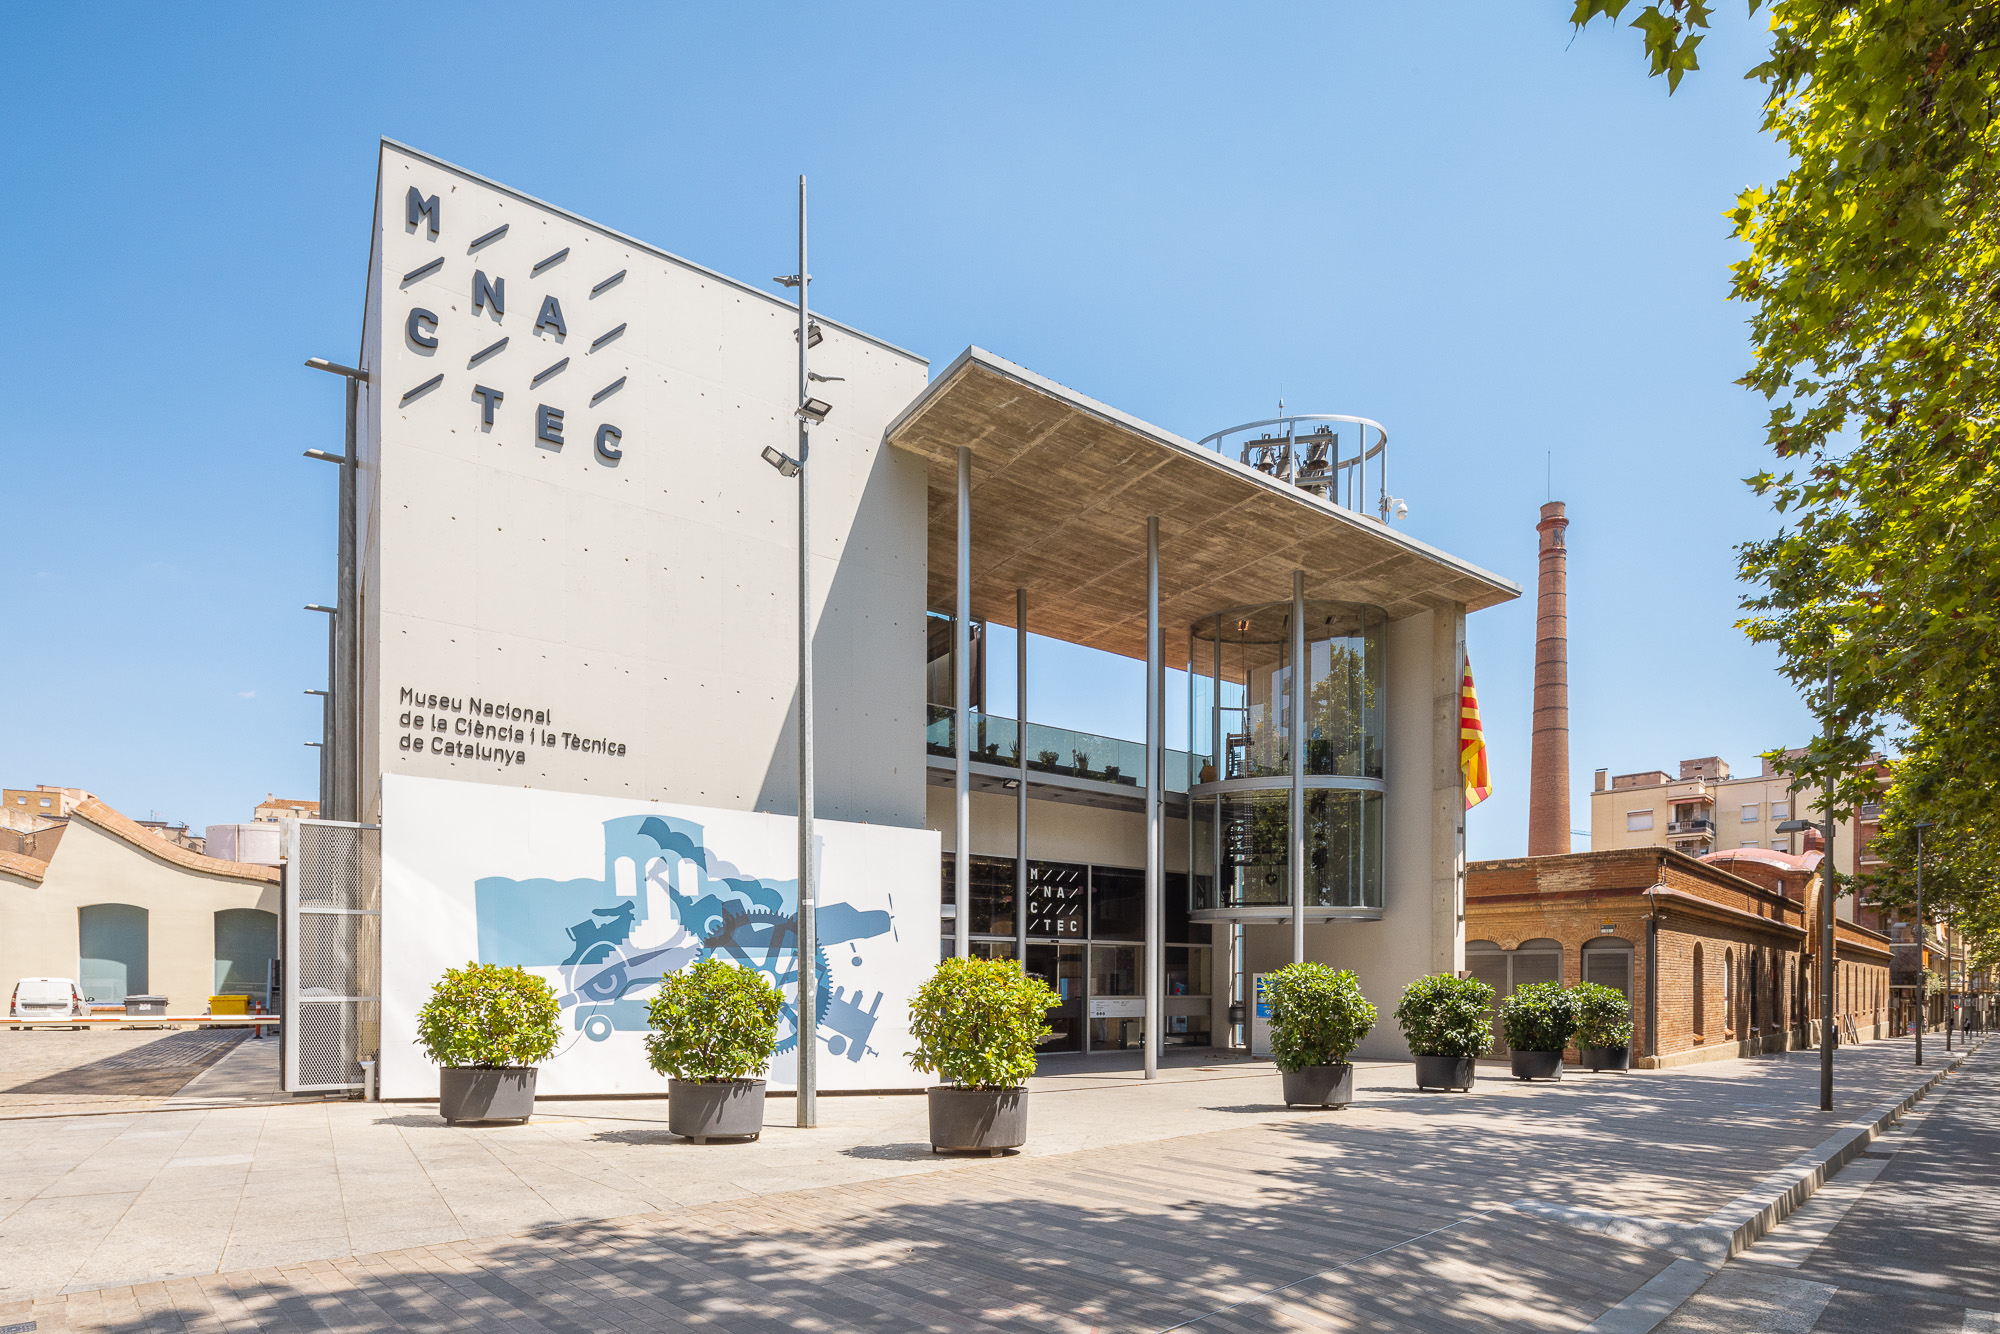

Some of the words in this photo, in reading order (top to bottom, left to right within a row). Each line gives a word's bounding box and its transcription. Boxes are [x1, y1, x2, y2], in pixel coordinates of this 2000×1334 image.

[399, 686, 462, 713] Museu
[469, 697, 552, 726] Nacional
[399, 711, 425, 731] de
[431, 713, 448, 734] la
[455, 717, 525, 744] Ciència
[530, 727, 536, 746] i
[541, 729, 557, 748] la
[562, 731, 627, 758] Tècnica
[399, 733, 424, 752] de
[431, 736, 526, 766] Catalunya
